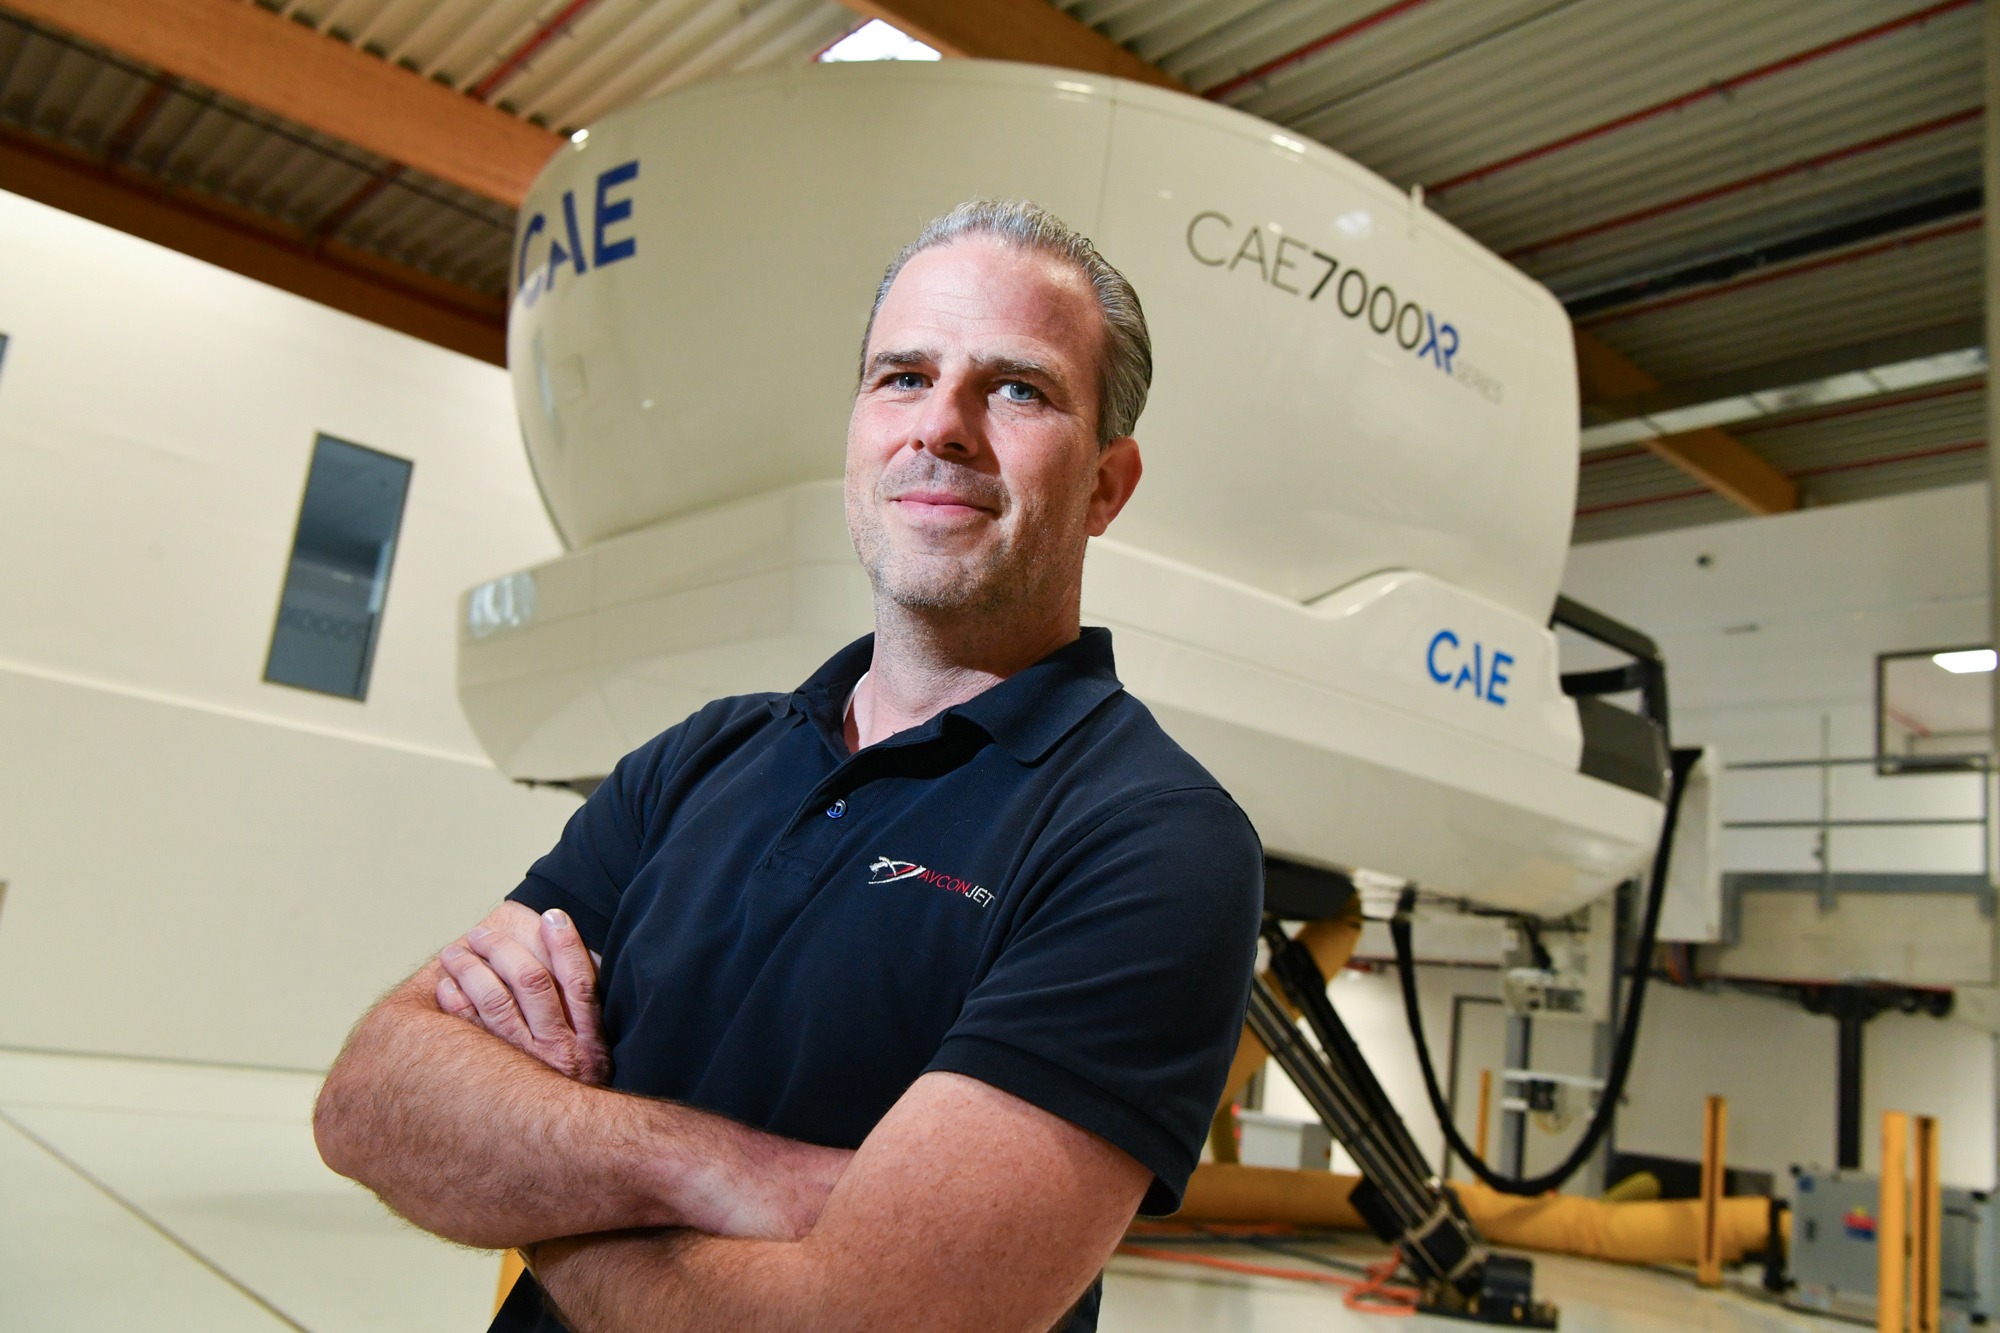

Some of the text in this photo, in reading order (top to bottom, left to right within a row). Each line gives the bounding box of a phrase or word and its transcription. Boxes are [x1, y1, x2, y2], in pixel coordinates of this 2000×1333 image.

[518, 159, 640, 308] CAE
[1427, 629, 1514, 706] CAE
[916, 869, 995, 908] AVCONJET
